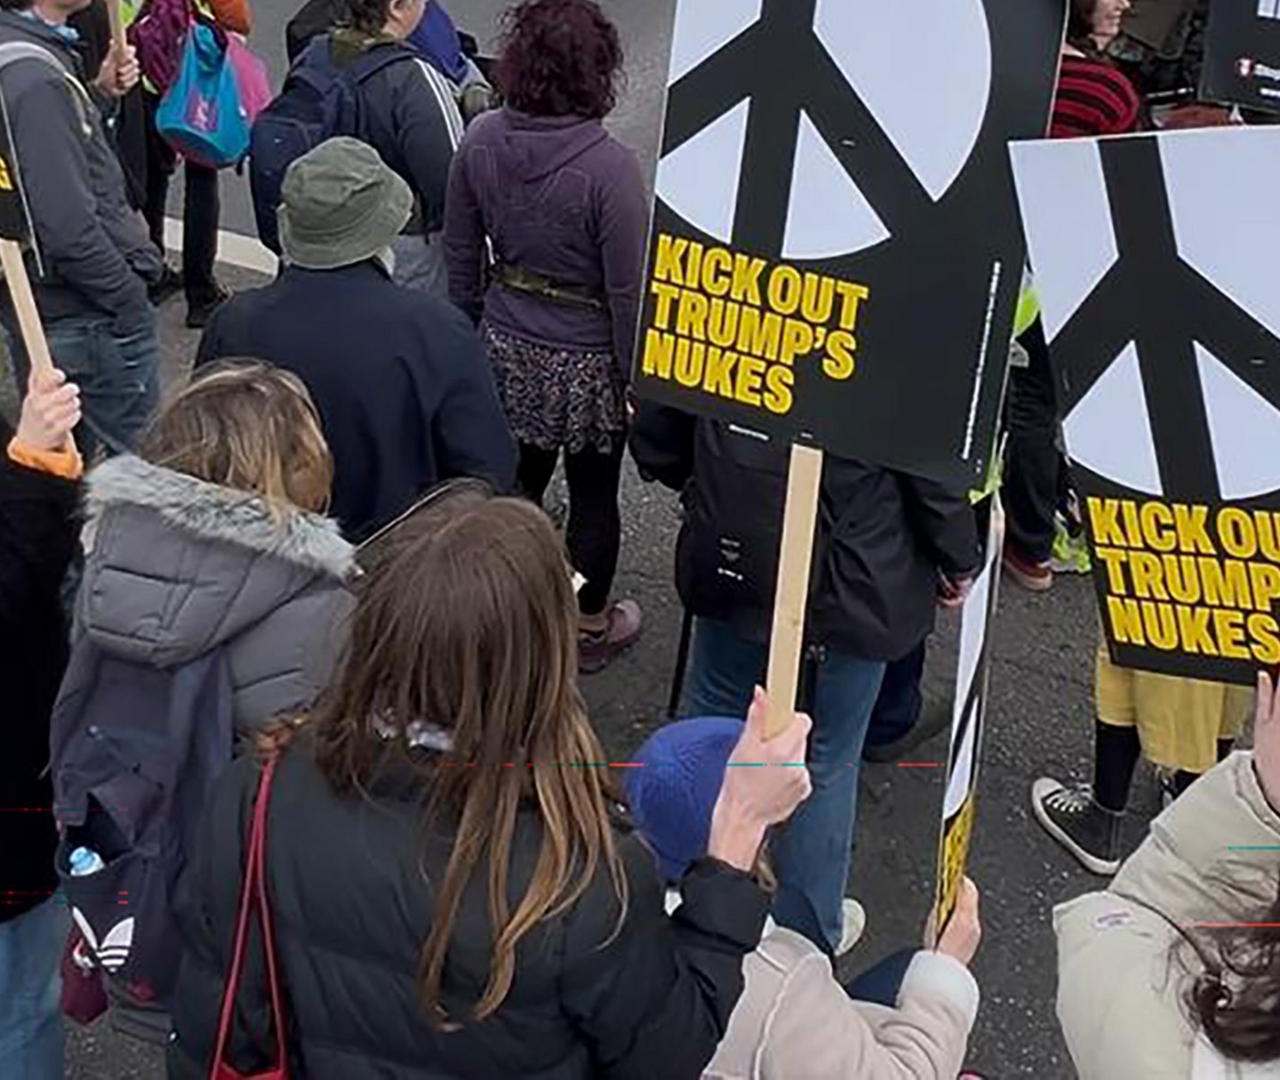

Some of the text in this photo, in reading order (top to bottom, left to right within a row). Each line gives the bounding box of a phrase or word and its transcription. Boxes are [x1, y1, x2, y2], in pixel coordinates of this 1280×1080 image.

[653, 233, 870, 332] KICK OUT
[642, 327, 795, 415] NUKES
[650, 280, 858, 380] TRUMP'S
[1087, 496, 1216, 555] KICK
